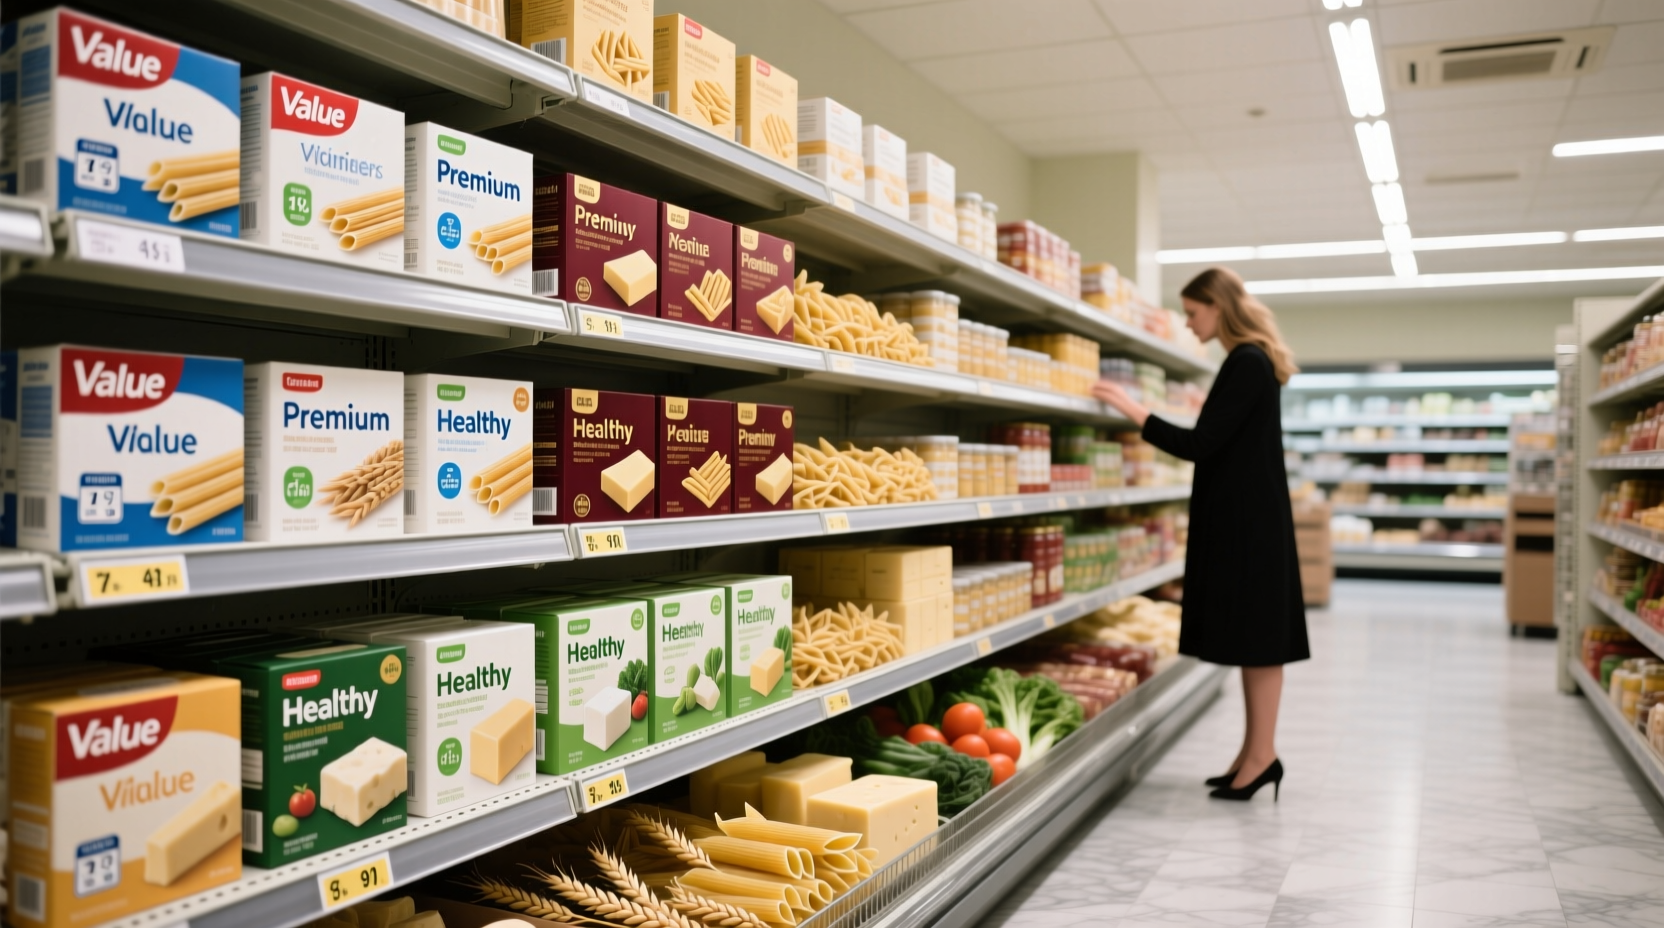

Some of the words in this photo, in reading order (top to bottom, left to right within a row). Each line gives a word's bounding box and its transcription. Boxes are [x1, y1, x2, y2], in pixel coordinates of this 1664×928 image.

[71, 26, 162, 81] Value
[281, 86, 346, 128] Value
[437, 159, 521, 201] Premium
[73, 359, 166, 398] Value
[283, 401, 390, 431] Premium
[437, 409, 511, 440] Healthy
[573, 418, 633, 445] Healthy
[567, 636, 625, 664] Healthy
[437, 662, 512, 697] Healthy
[283, 686, 378, 727] Healthy
[67, 715, 161, 760] Value
